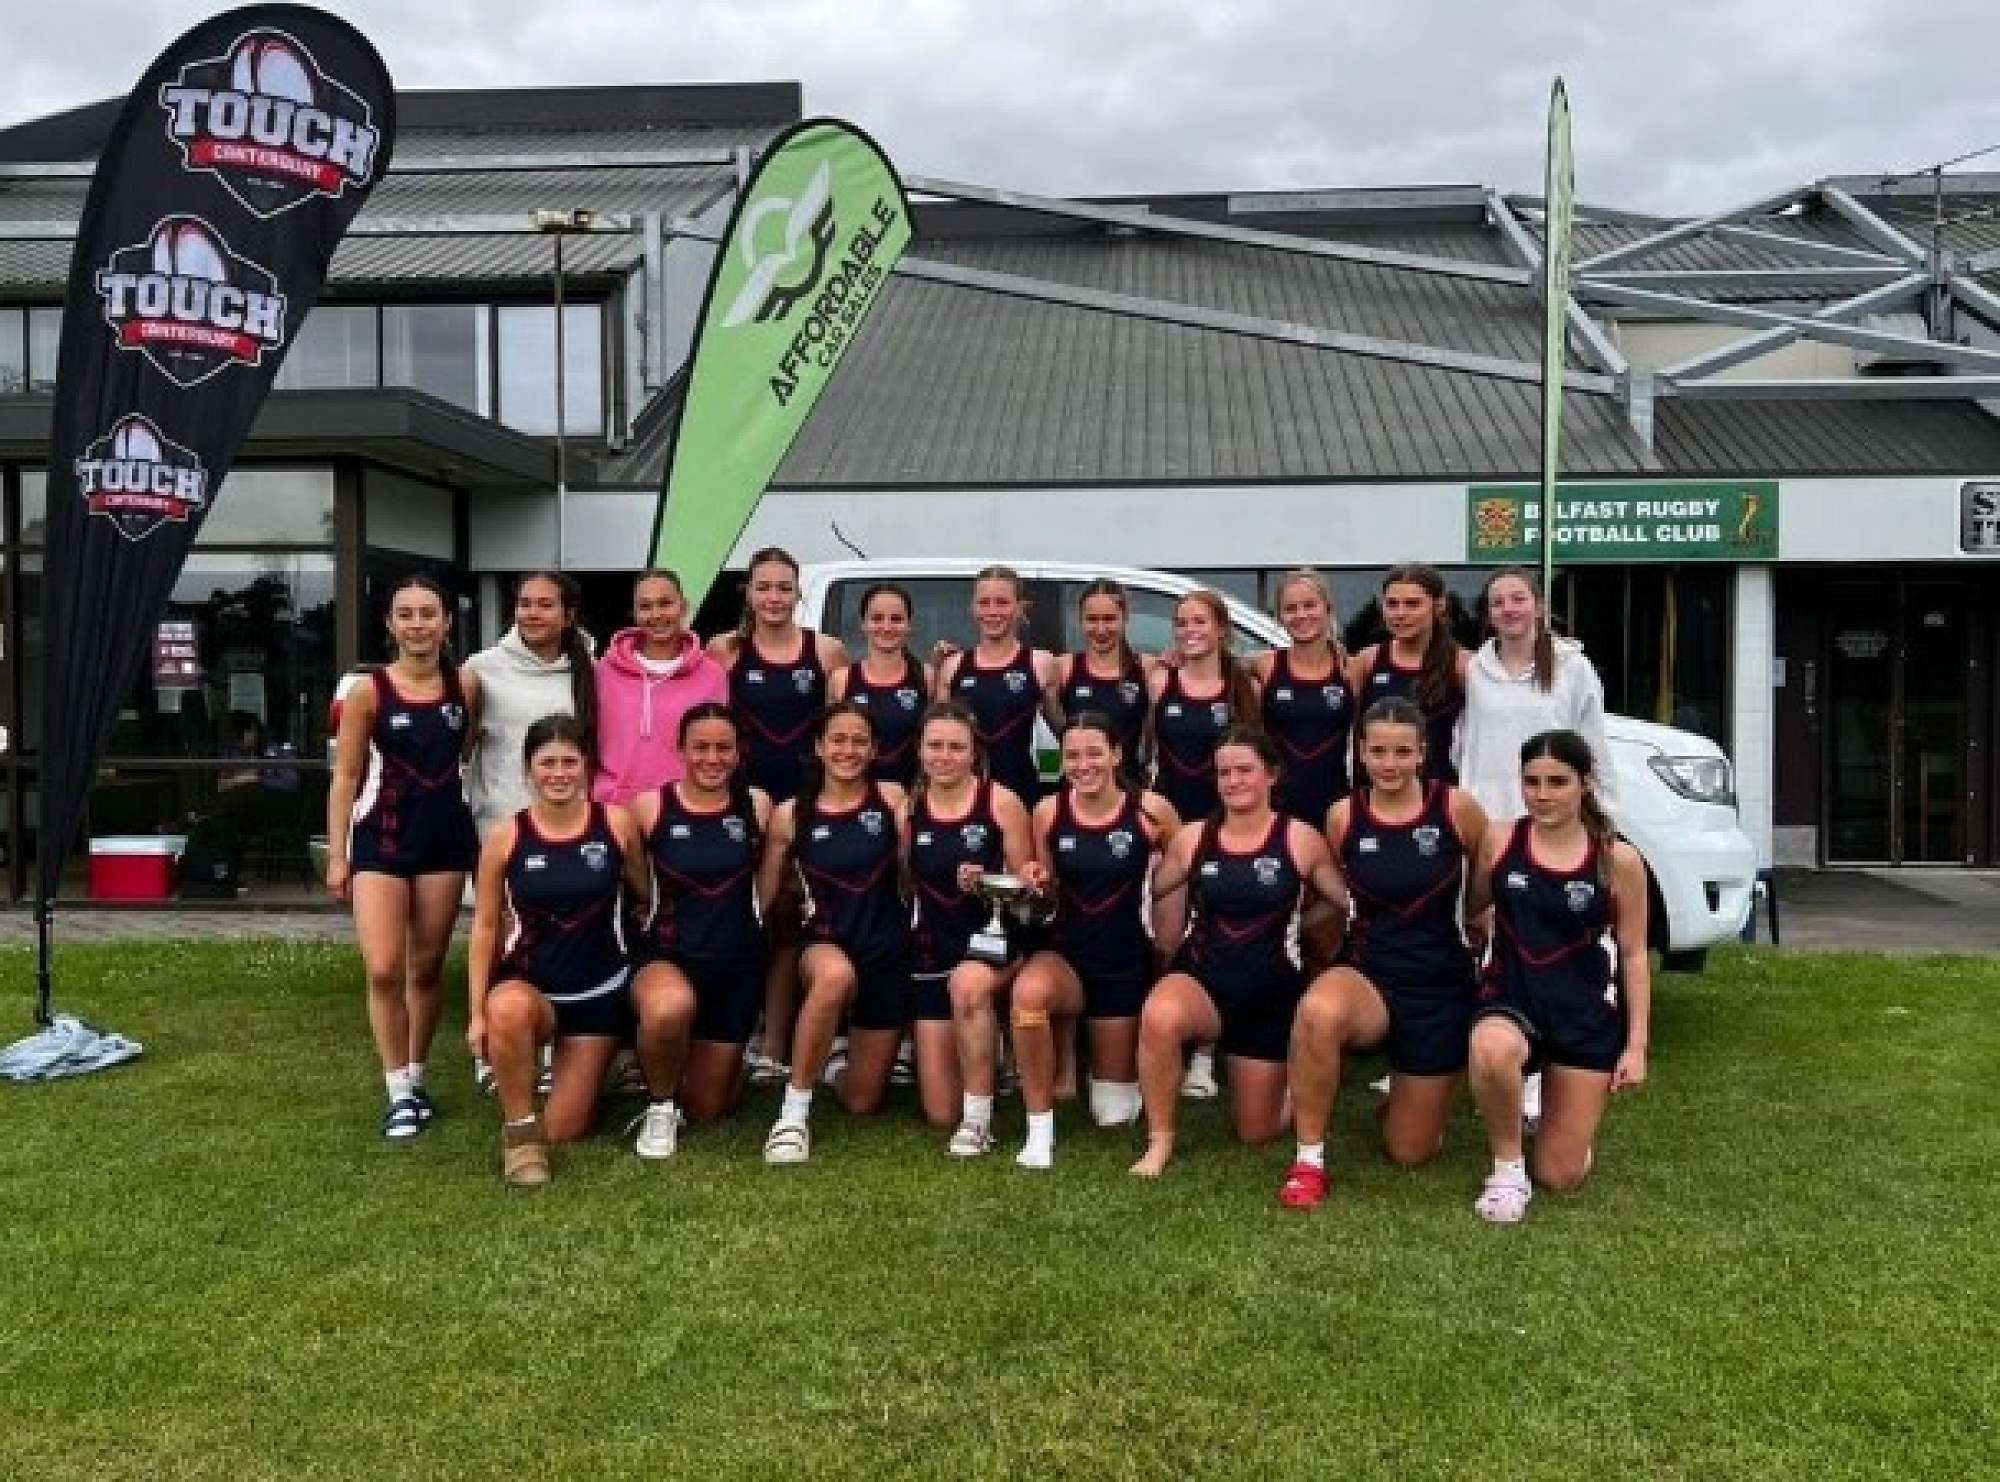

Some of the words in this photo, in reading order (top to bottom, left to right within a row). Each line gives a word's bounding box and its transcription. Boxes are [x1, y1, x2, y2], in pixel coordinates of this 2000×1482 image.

[165, 88, 373, 175] TOUCH
[101, 273, 278, 340] TOUCH
[769, 197, 898, 407] AFFORDABLE
[819, 327, 845, 367] CAR
[841, 266, 883, 327] SALES
[78, 461, 202, 502] TOUCH
[1524, 500, 1628, 519] BLFAST
[1636, 498, 1721, 518] RUGBY
[1524, 525, 1648, 545] FOTBALL
[1656, 524, 1721, 542] CLUB
